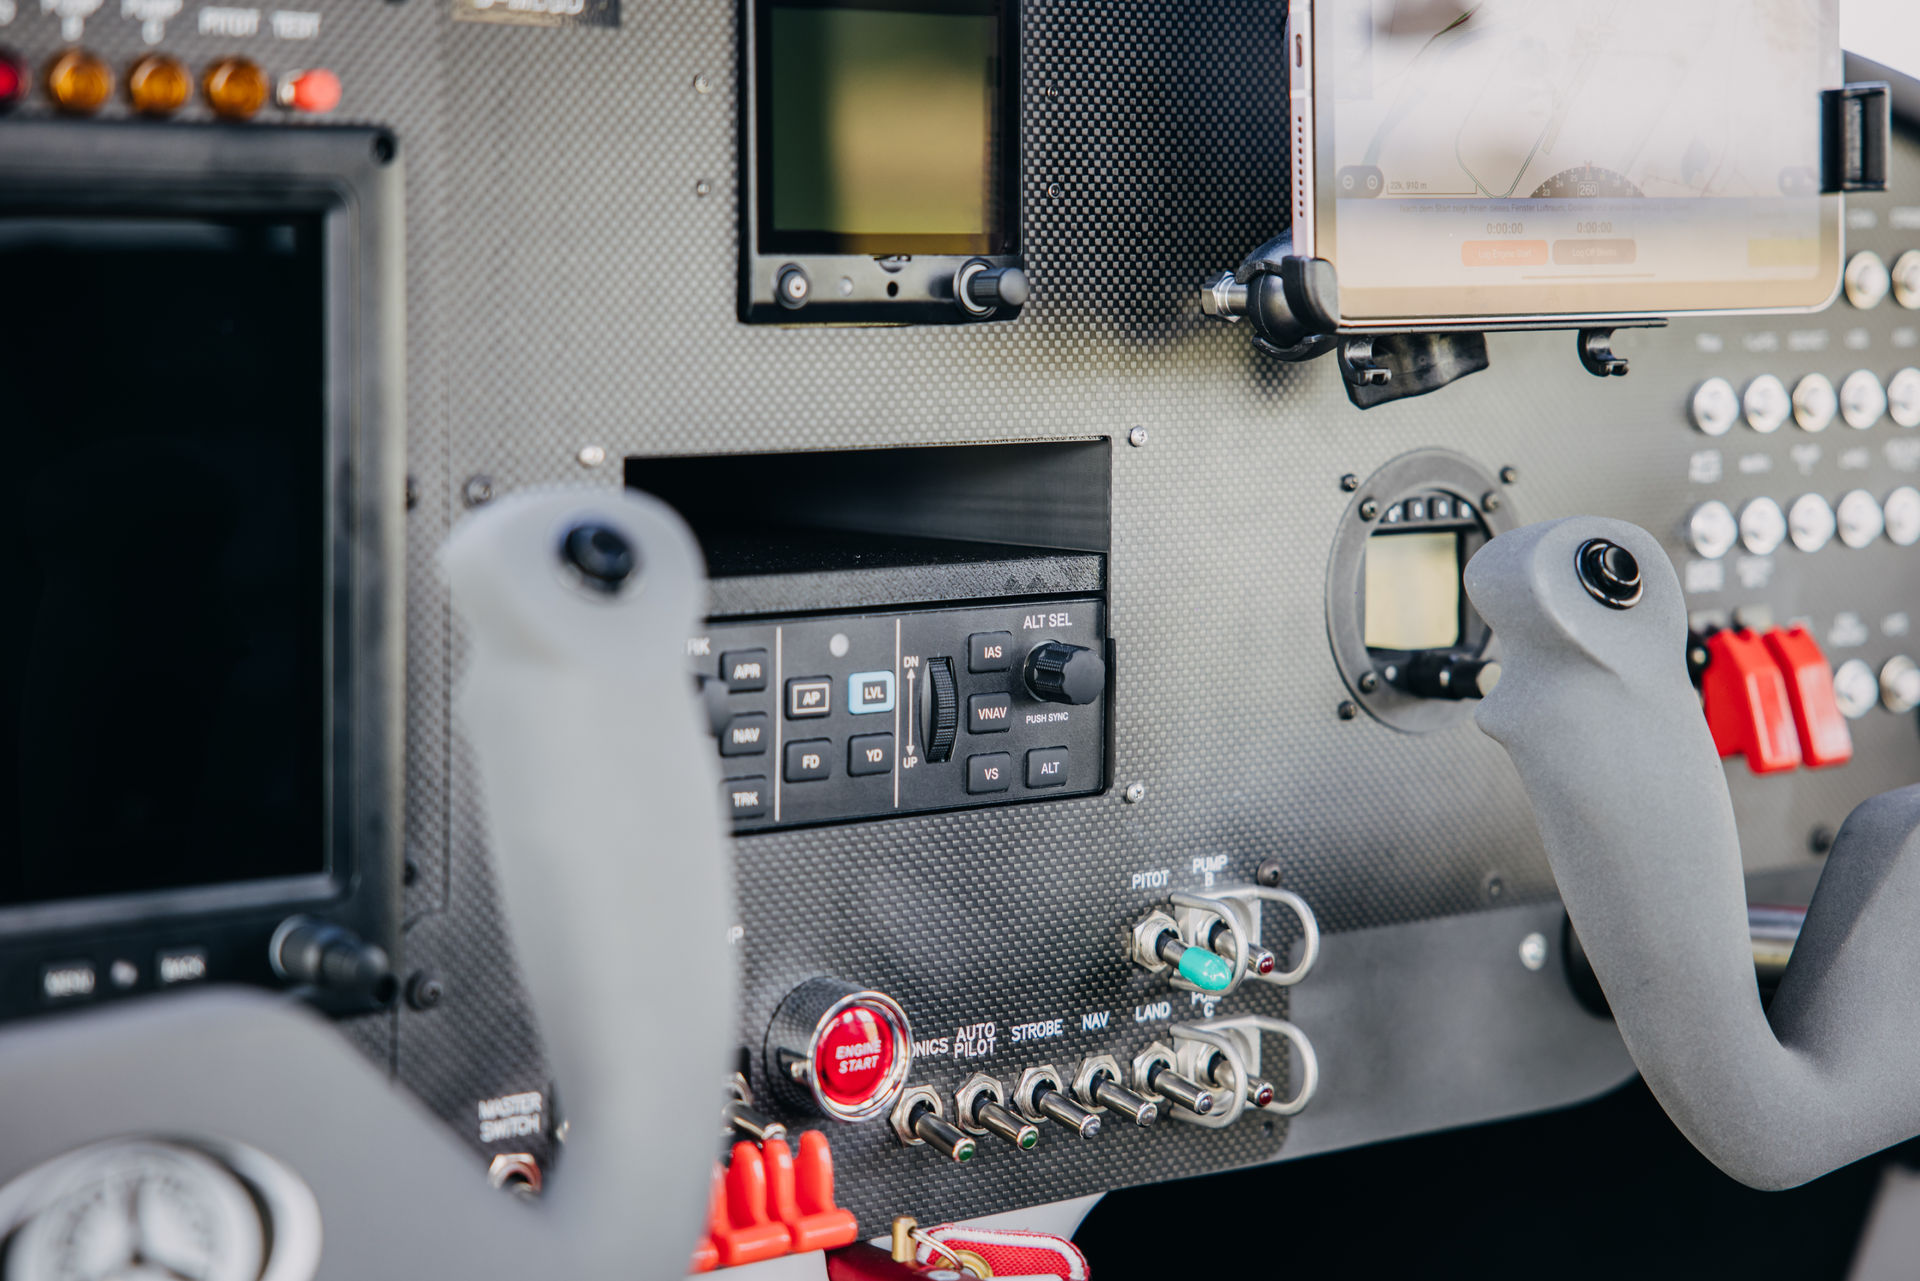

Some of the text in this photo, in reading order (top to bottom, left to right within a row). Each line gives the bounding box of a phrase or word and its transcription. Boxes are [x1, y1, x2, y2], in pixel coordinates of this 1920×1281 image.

[1579, 184, 1598, 196] 260
[1486, 222, 1523, 234] 0:00:00
[1577, 222, 1612, 234] 0:00:00
[1023, 613, 1072, 629] ALT SEL
[984, 646, 1002, 660] IAS
[904, 656, 918, 668] DN
[733, 663, 760, 680] APR
[802, 691, 821, 706] AP
[864, 686, 884, 700] LVL
[978, 706, 1008, 720] VNAV
[1026, 712, 1070, 724] PUSH SYNC
[732, 728, 760, 744] NAV
[802, 754, 820, 769] FD
[866, 748, 883, 762] YD
[903, 756, 918, 769] UP
[984, 768, 998, 780] VS
[1040, 762, 1060, 775] ALT
[732, 792, 759, 807] TRK
[1192, 854, 1228, 874] PUMP
[1132, 869, 1170, 890] PITOT
[1205, 872, 1214, 888] B
[1135, 1001, 1172, 1022] LAND
[1204, 1002, 1215, 1018] C
[1082, 1012, 1110, 1030] NAV
[956, 1022, 996, 1042] AUTO
[1011, 1019, 1064, 1042] STROBE
[836, 1040, 882, 1060] ENGINE
[954, 1036, 996, 1058] PILOT
[838, 1054, 880, 1074] START
[478, 1091, 542, 1120] MASTER
[480, 1112, 540, 1142] SWITCH
